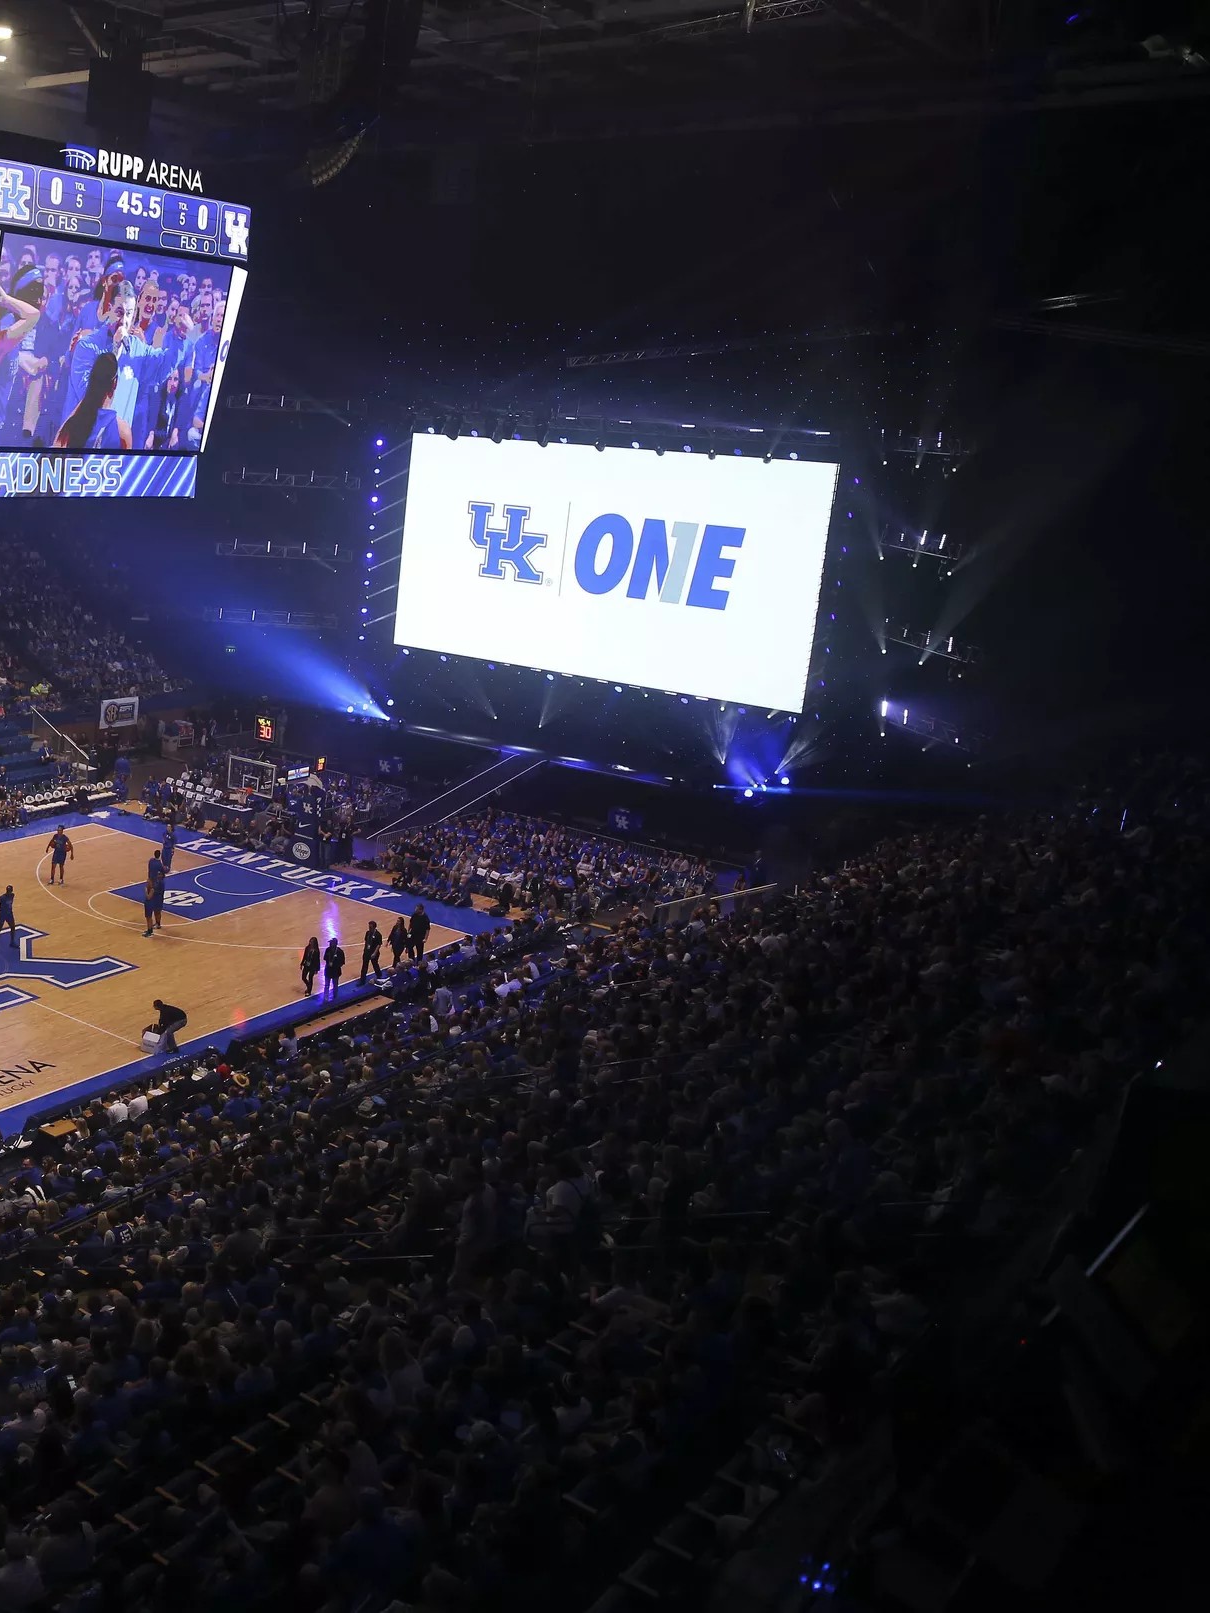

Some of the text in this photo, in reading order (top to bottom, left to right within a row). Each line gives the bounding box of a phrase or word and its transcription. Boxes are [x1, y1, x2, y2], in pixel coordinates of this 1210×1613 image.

[97, 149, 204, 193] RUPP ARENA
[50, 176, 63, 205] 0
[75, 181, 86, 192] TOL
[76, 193, 83, 208] 5
[116, 190, 162, 219] 45.5
[178, 201, 189, 211] TOL
[47, 217, 78, 232] 0 FLS
[179, 212, 186, 226] 5
[197, 204, 208, 230] 0
[125, 225, 140, 241] 1ST
[180, 235, 209, 252] FLS 0
[467, 500, 548, 585] UK
[259, 726, 272, 739] 30
[175, 837, 402, 902] KENTUCKY
